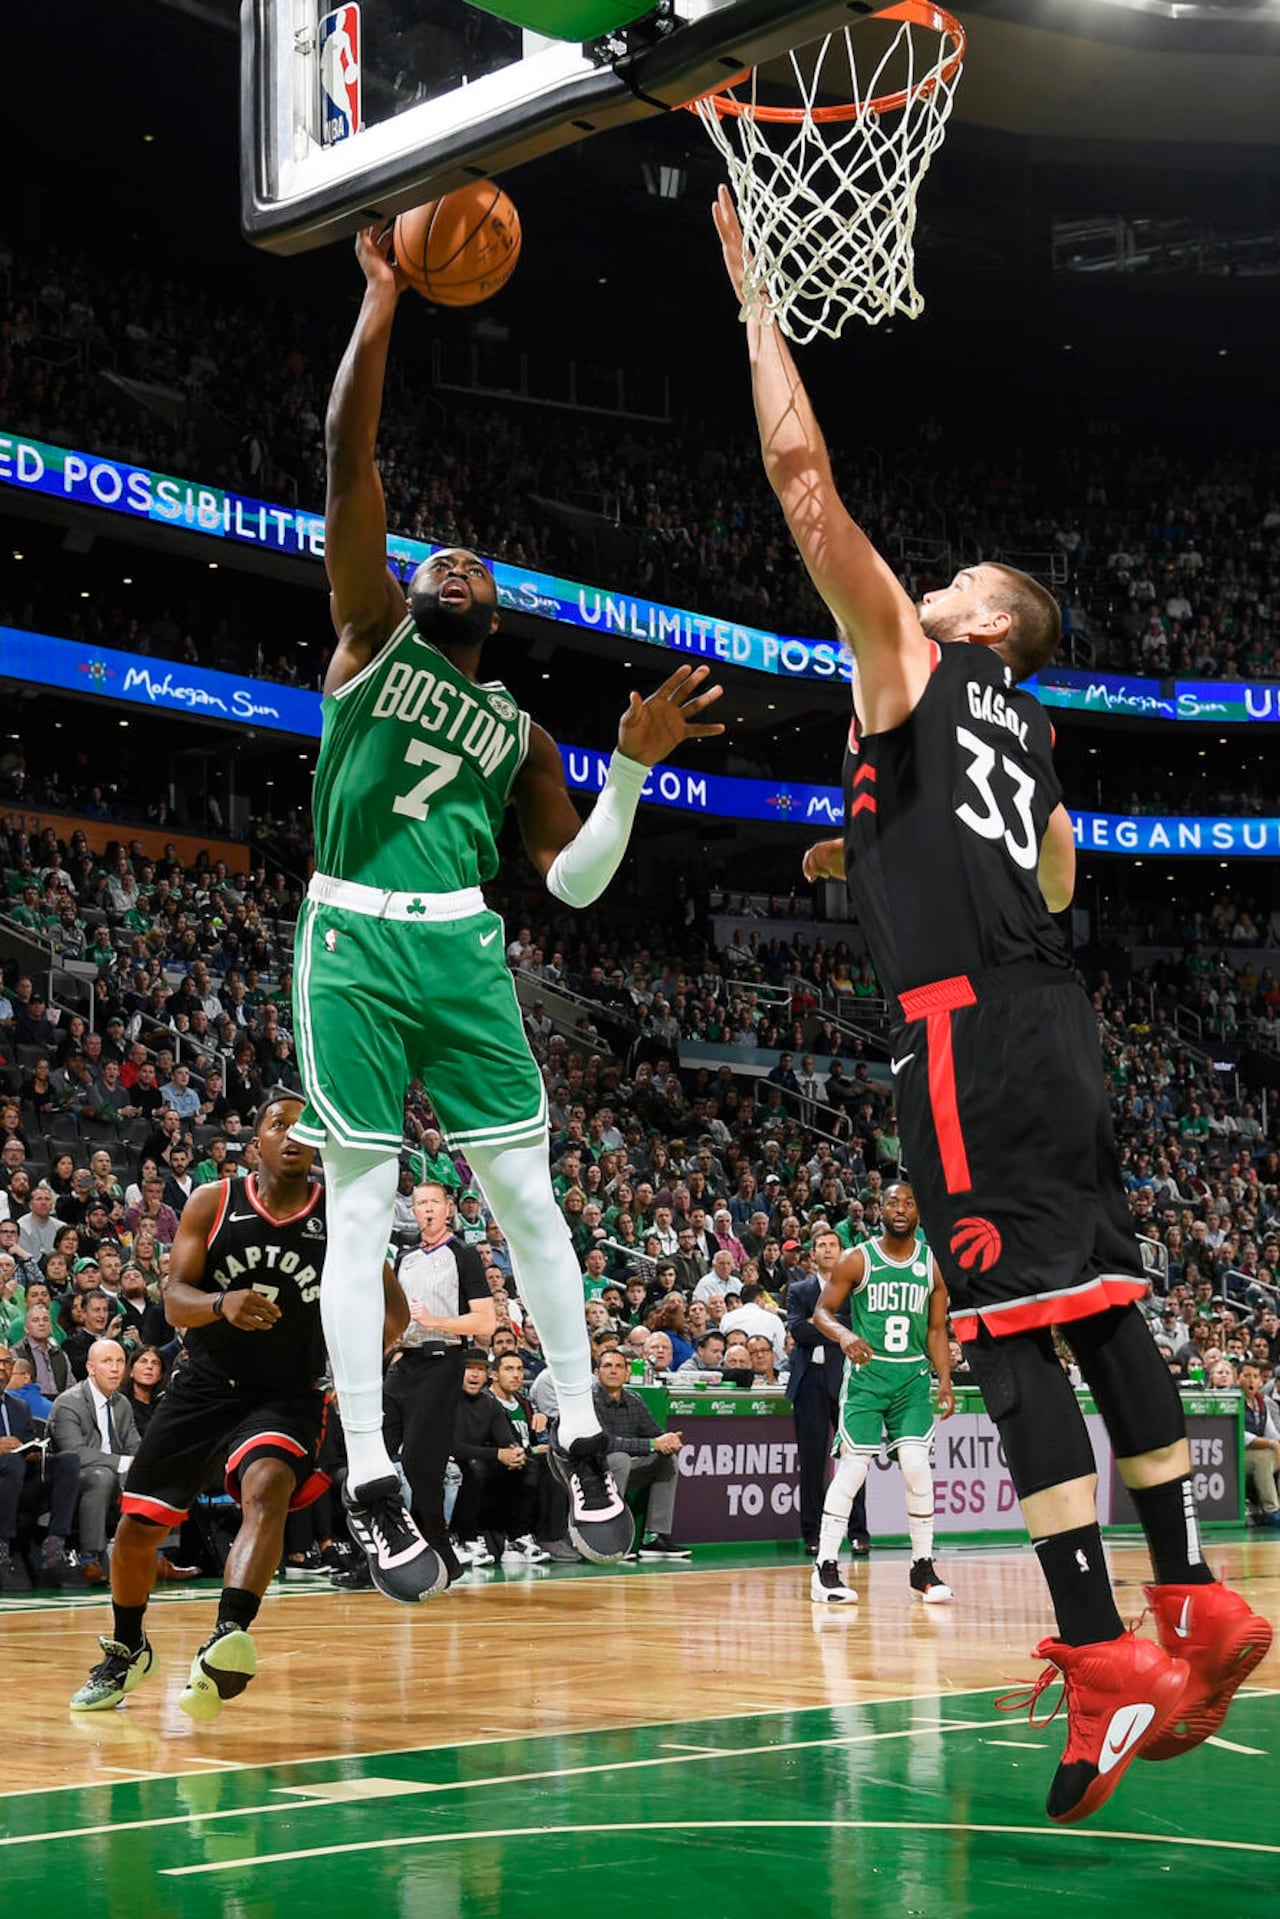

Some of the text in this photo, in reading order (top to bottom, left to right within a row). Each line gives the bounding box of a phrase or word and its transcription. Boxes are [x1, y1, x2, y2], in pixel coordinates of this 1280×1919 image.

[577, 589, 751, 662] UNLIMITED
[123, 667, 280, 718] Mohegan Sun
[1085, 684, 1280, 718] Mohegan Sun U
[371, 661, 516, 779] BOSTON
[966, 681, 1030, 753] GASOL
[391, 738, 464, 822] 7
[955, 725, 1039, 870] 33
[1072, 817, 1280, 850] HEGANSU
[213, 1245, 321, 1303] RAPTORS
[867, 1281, 929, 1315] BOSTON
[884, 1315, 911, 1353] 8
[677, 1443, 801, 1477] CABINET
[726, 1483, 765, 1516] TO
[1193, 1472, 1226, 1501] GO
